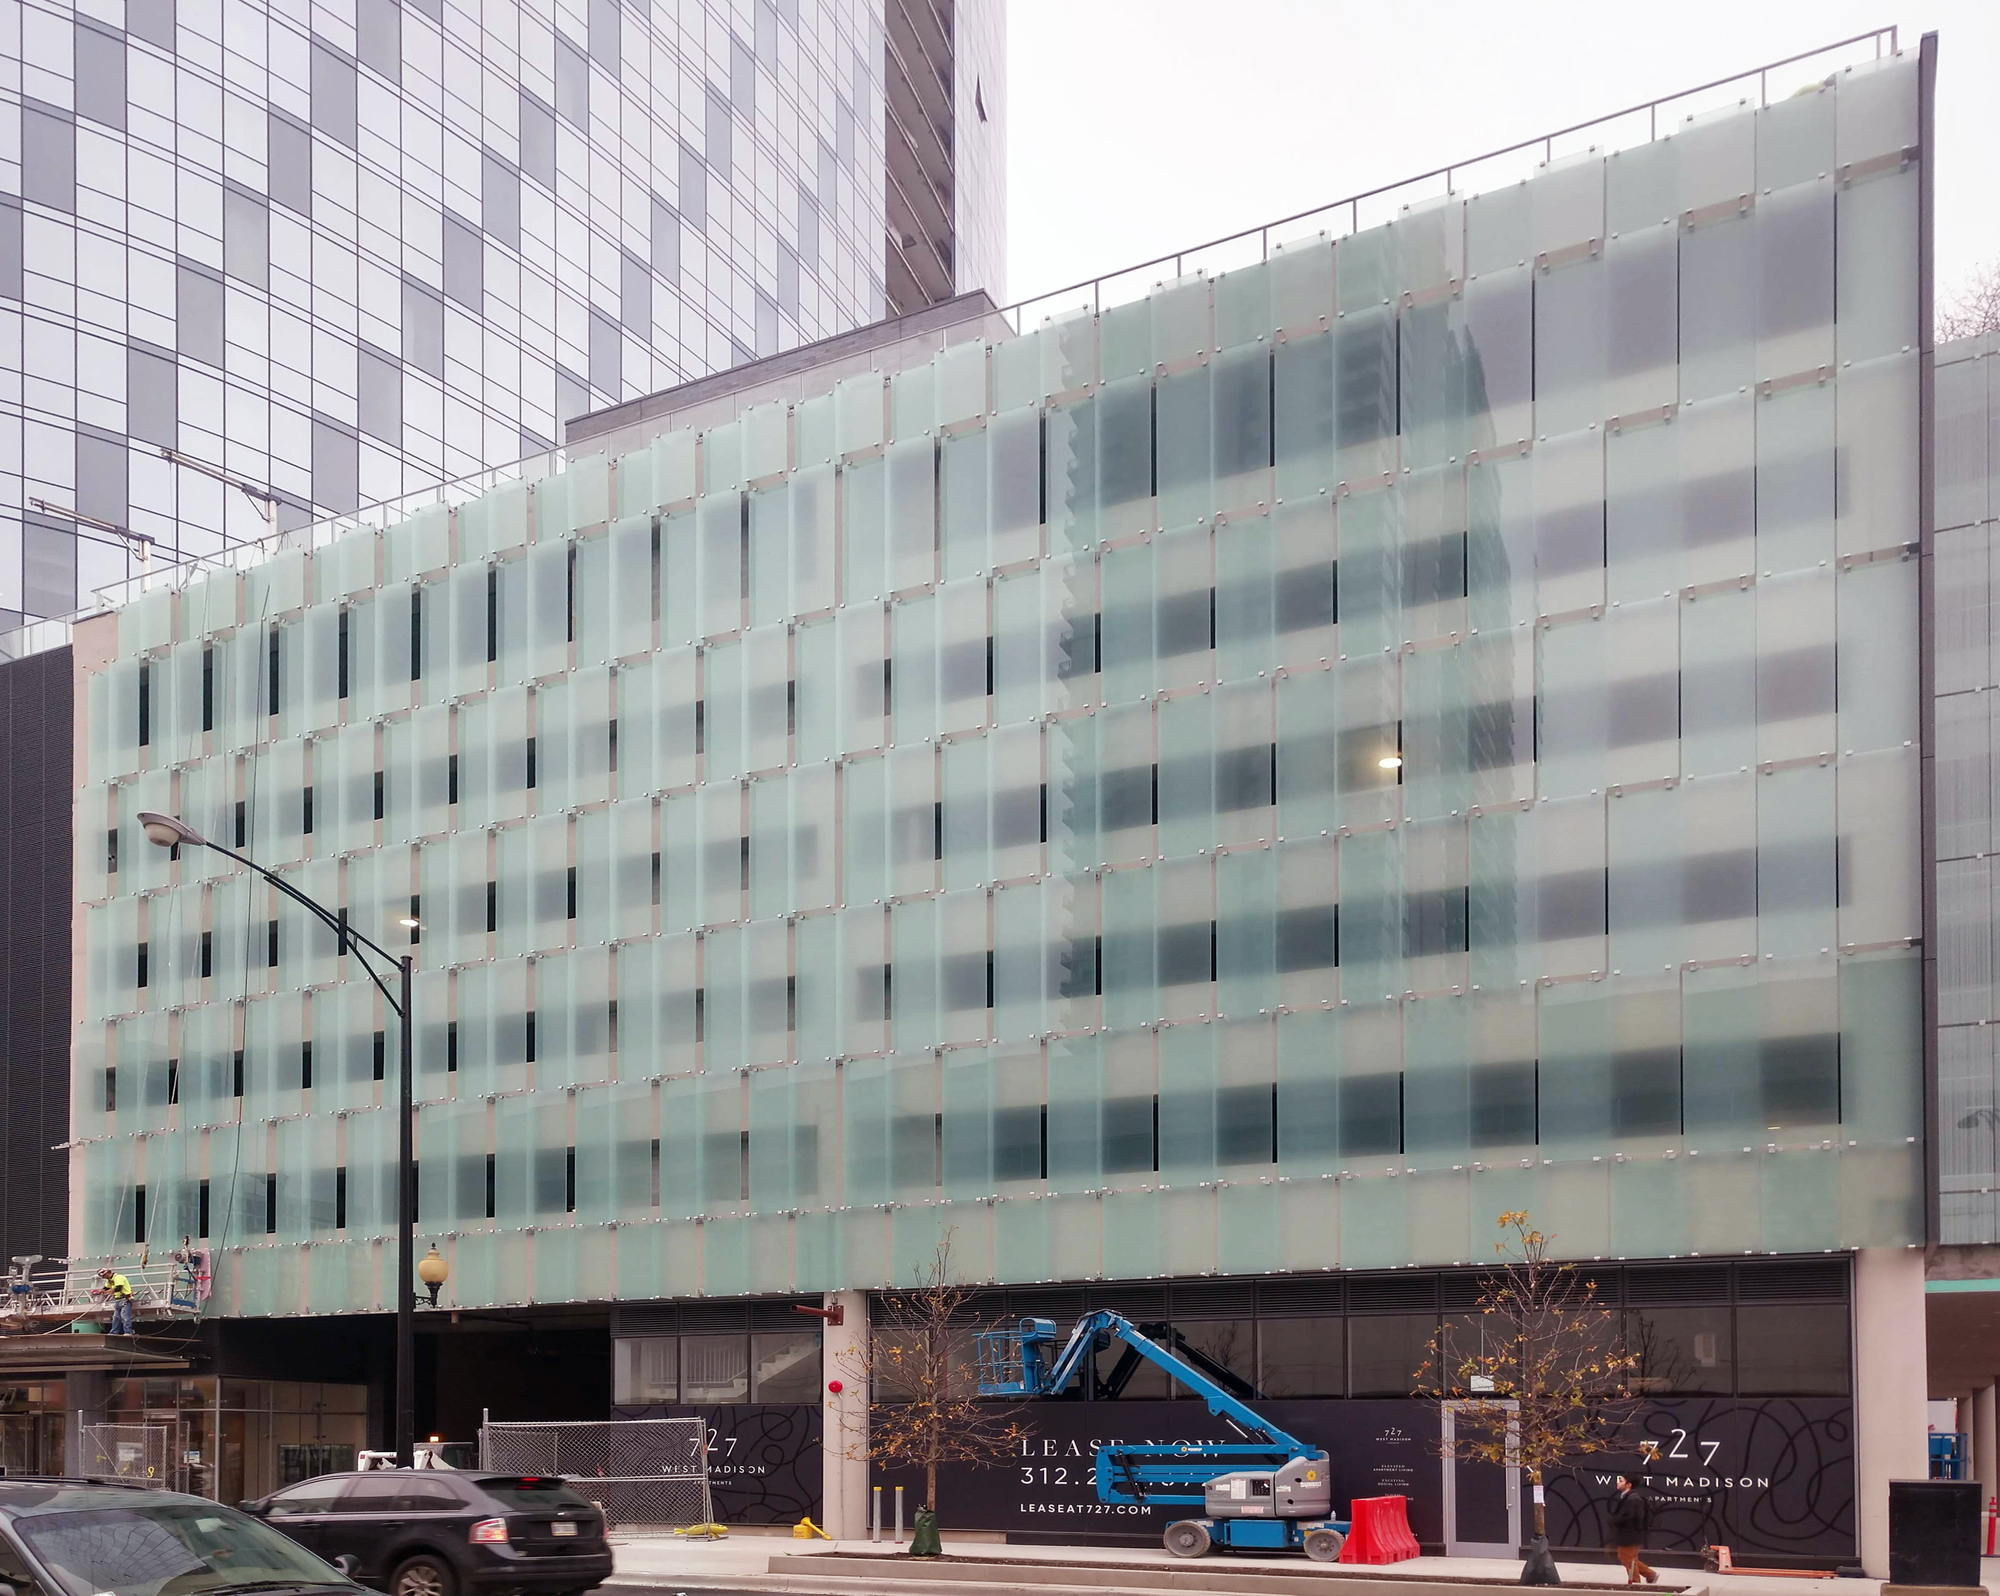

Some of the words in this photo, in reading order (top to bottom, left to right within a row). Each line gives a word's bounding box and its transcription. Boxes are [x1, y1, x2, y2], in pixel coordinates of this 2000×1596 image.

[1384, 1427, 1402, 1437] 727
[689, 1428, 737, 1457] 727
[1640, 1428, 1720, 1466] 727
[661, 1465, 698, 1474] WEST
[1665, 1476, 1770, 1489] MADISON
[1020, 1503, 1152, 1516] LEASEAT727.COM
